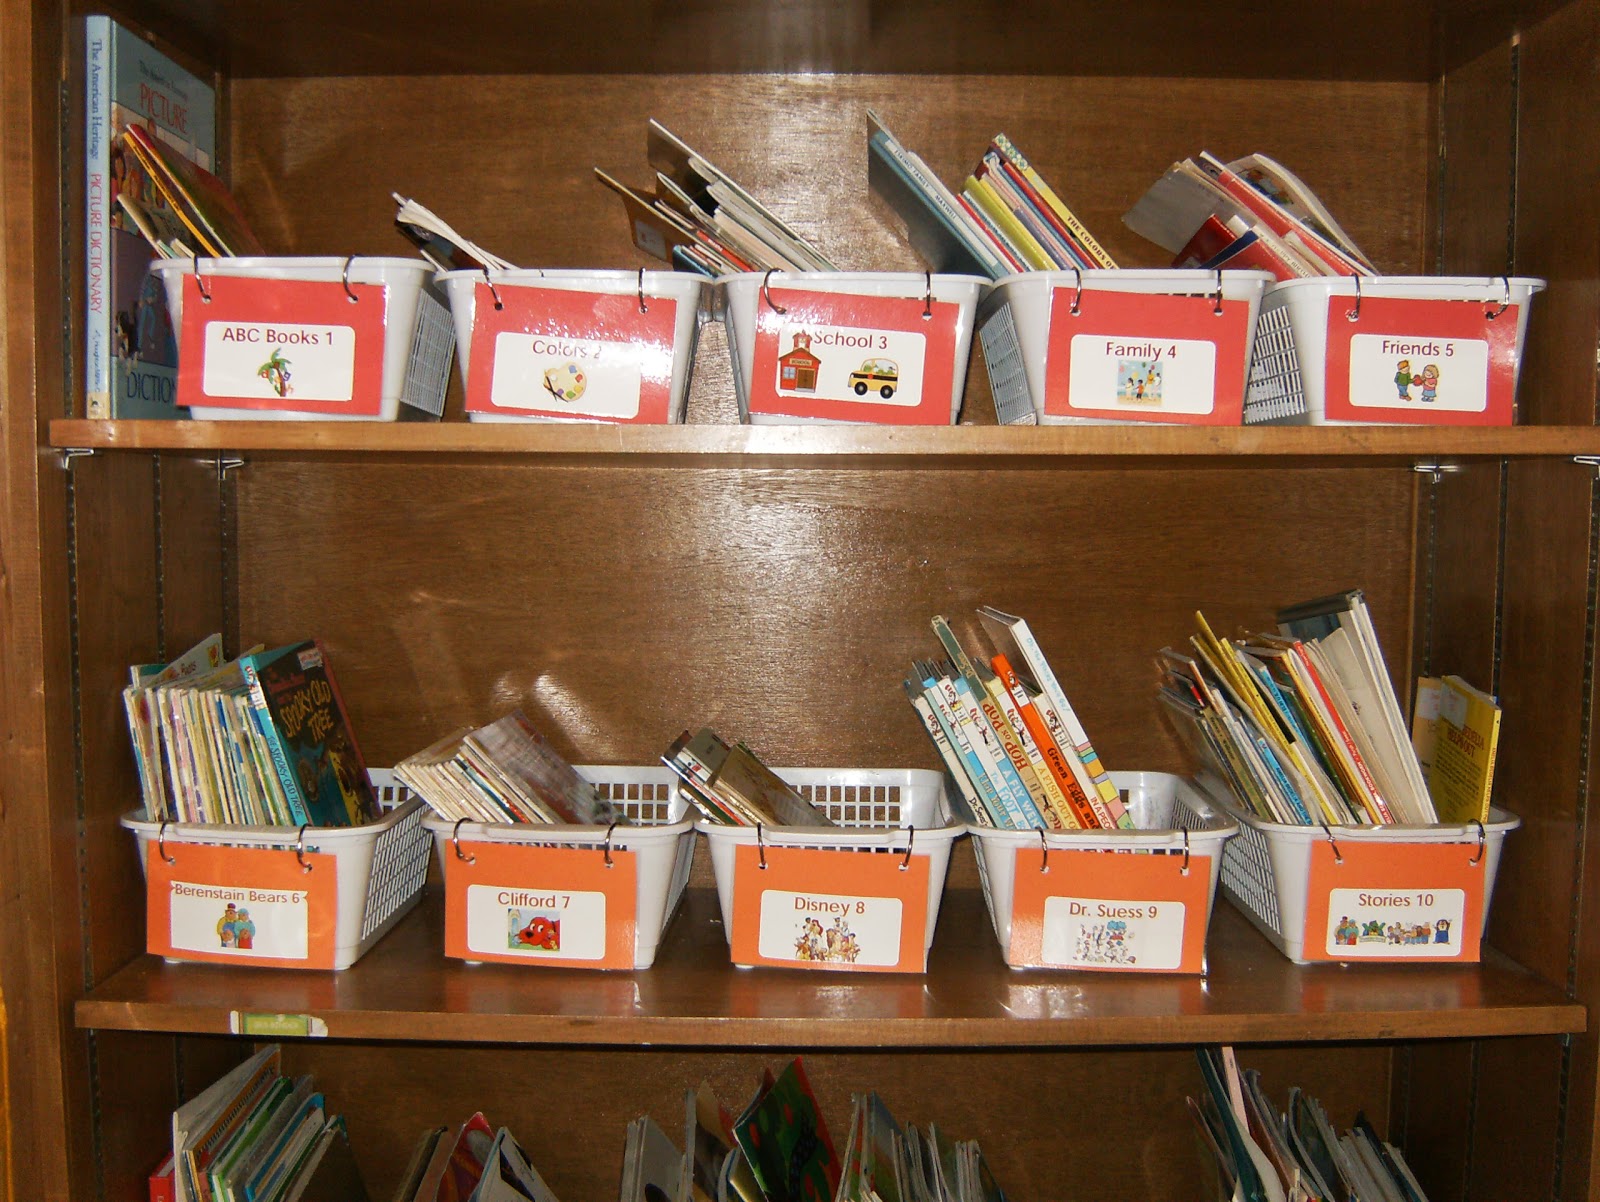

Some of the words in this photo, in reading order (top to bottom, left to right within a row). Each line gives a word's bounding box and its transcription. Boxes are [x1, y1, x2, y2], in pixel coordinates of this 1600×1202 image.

[92, 39, 103, 60] The
[92, 63, 102, 114] American
[139, 82, 188, 136] PICTURE
[90, 116, 103, 160] Heritage
[90, 173, 103, 227] PICTURE
[1067, 216, 1081, 231] THE
[1080, 231, 1106, 261] COLORS
[90, 231, 103, 315] DICTIONARY
[222, 327, 260, 342] ABC
[266, 328, 320, 345] Books
[325, 331, 334, 345] 1
[813, 330, 873, 349] School
[878, 335, 888, 350] 3
[532, 339, 588, 359] Colors
[1105, 341, 1162, 362] Family
[1167, 344, 1177, 359] 4
[1381, 339, 1441, 357] Friends
[1445, 343, 1454, 357] 5
[279, 686, 313, 739] SPOOKY
[310, 680, 332, 708] OLD
[982, 702, 1004, 733] POP
[307, 707, 334, 745] TREE
[1004, 741, 1029, 772] HOP
[271, 747, 287, 776] SPOOKY
[283, 778, 297, 795] OLD
[1038, 767, 1047, 775] A
[1047, 747, 1069, 779] Green
[1066, 782, 1086, 809] Eggs
[1002, 769, 1012, 778] A
[1009, 779, 1025, 798] FLY
[1042, 775, 1060, 798] FISH
[997, 786, 1020, 814] FOOT
[1056, 800, 1073, 821] OUT
[1098, 811, 1113, 829] PEO
[174, 883, 245, 901] Berenstain
[249, 890, 288, 904] Bears
[291, 892, 301, 904] 6
[497, 891, 556, 909] Clifford
[561, 895, 571, 909] 7
[1358, 893, 1411, 907] Stories
[1416, 893, 1434, 907] 10
[794, 896, 851, 917] Disney
[855, 901, 866, 914] 8
[1069, 901, 1092, 917] Dr.
[1097, 903, 1144, 919] Suess
[1148, 905, 1158, 919] 9
